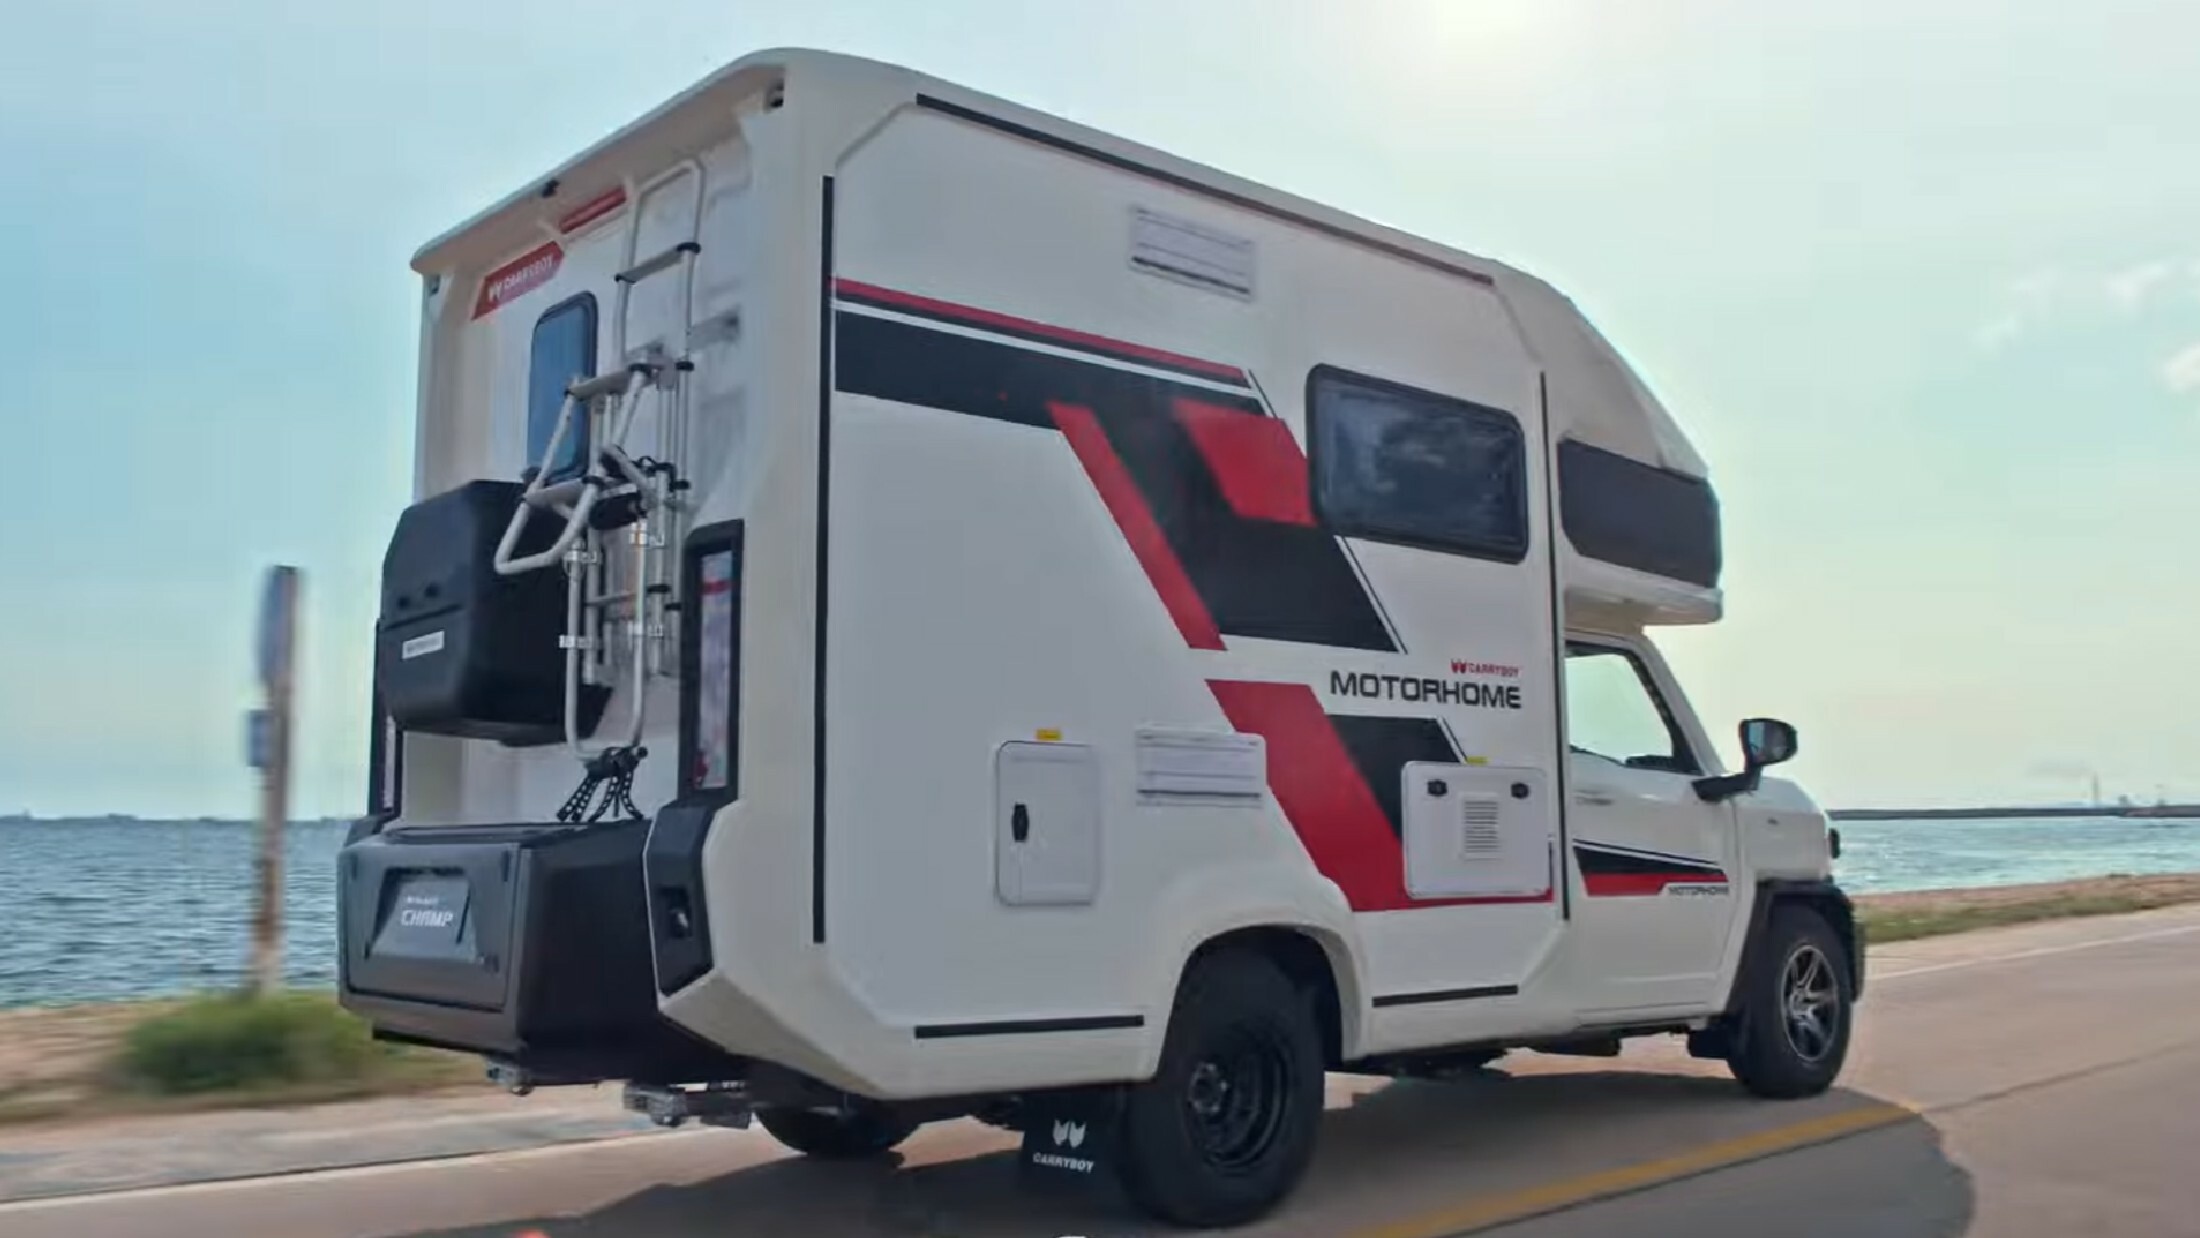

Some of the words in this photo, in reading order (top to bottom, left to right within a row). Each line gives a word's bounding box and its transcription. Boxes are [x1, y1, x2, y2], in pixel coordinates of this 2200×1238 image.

[1468, 663, 1519, 677] CARRYBOY
[1330, 670, 1522, 709] MOTORHOME
[401, 909, 454, 927] CHAMP
[1032, 1152, 1094, 1173] CARRYBOY
